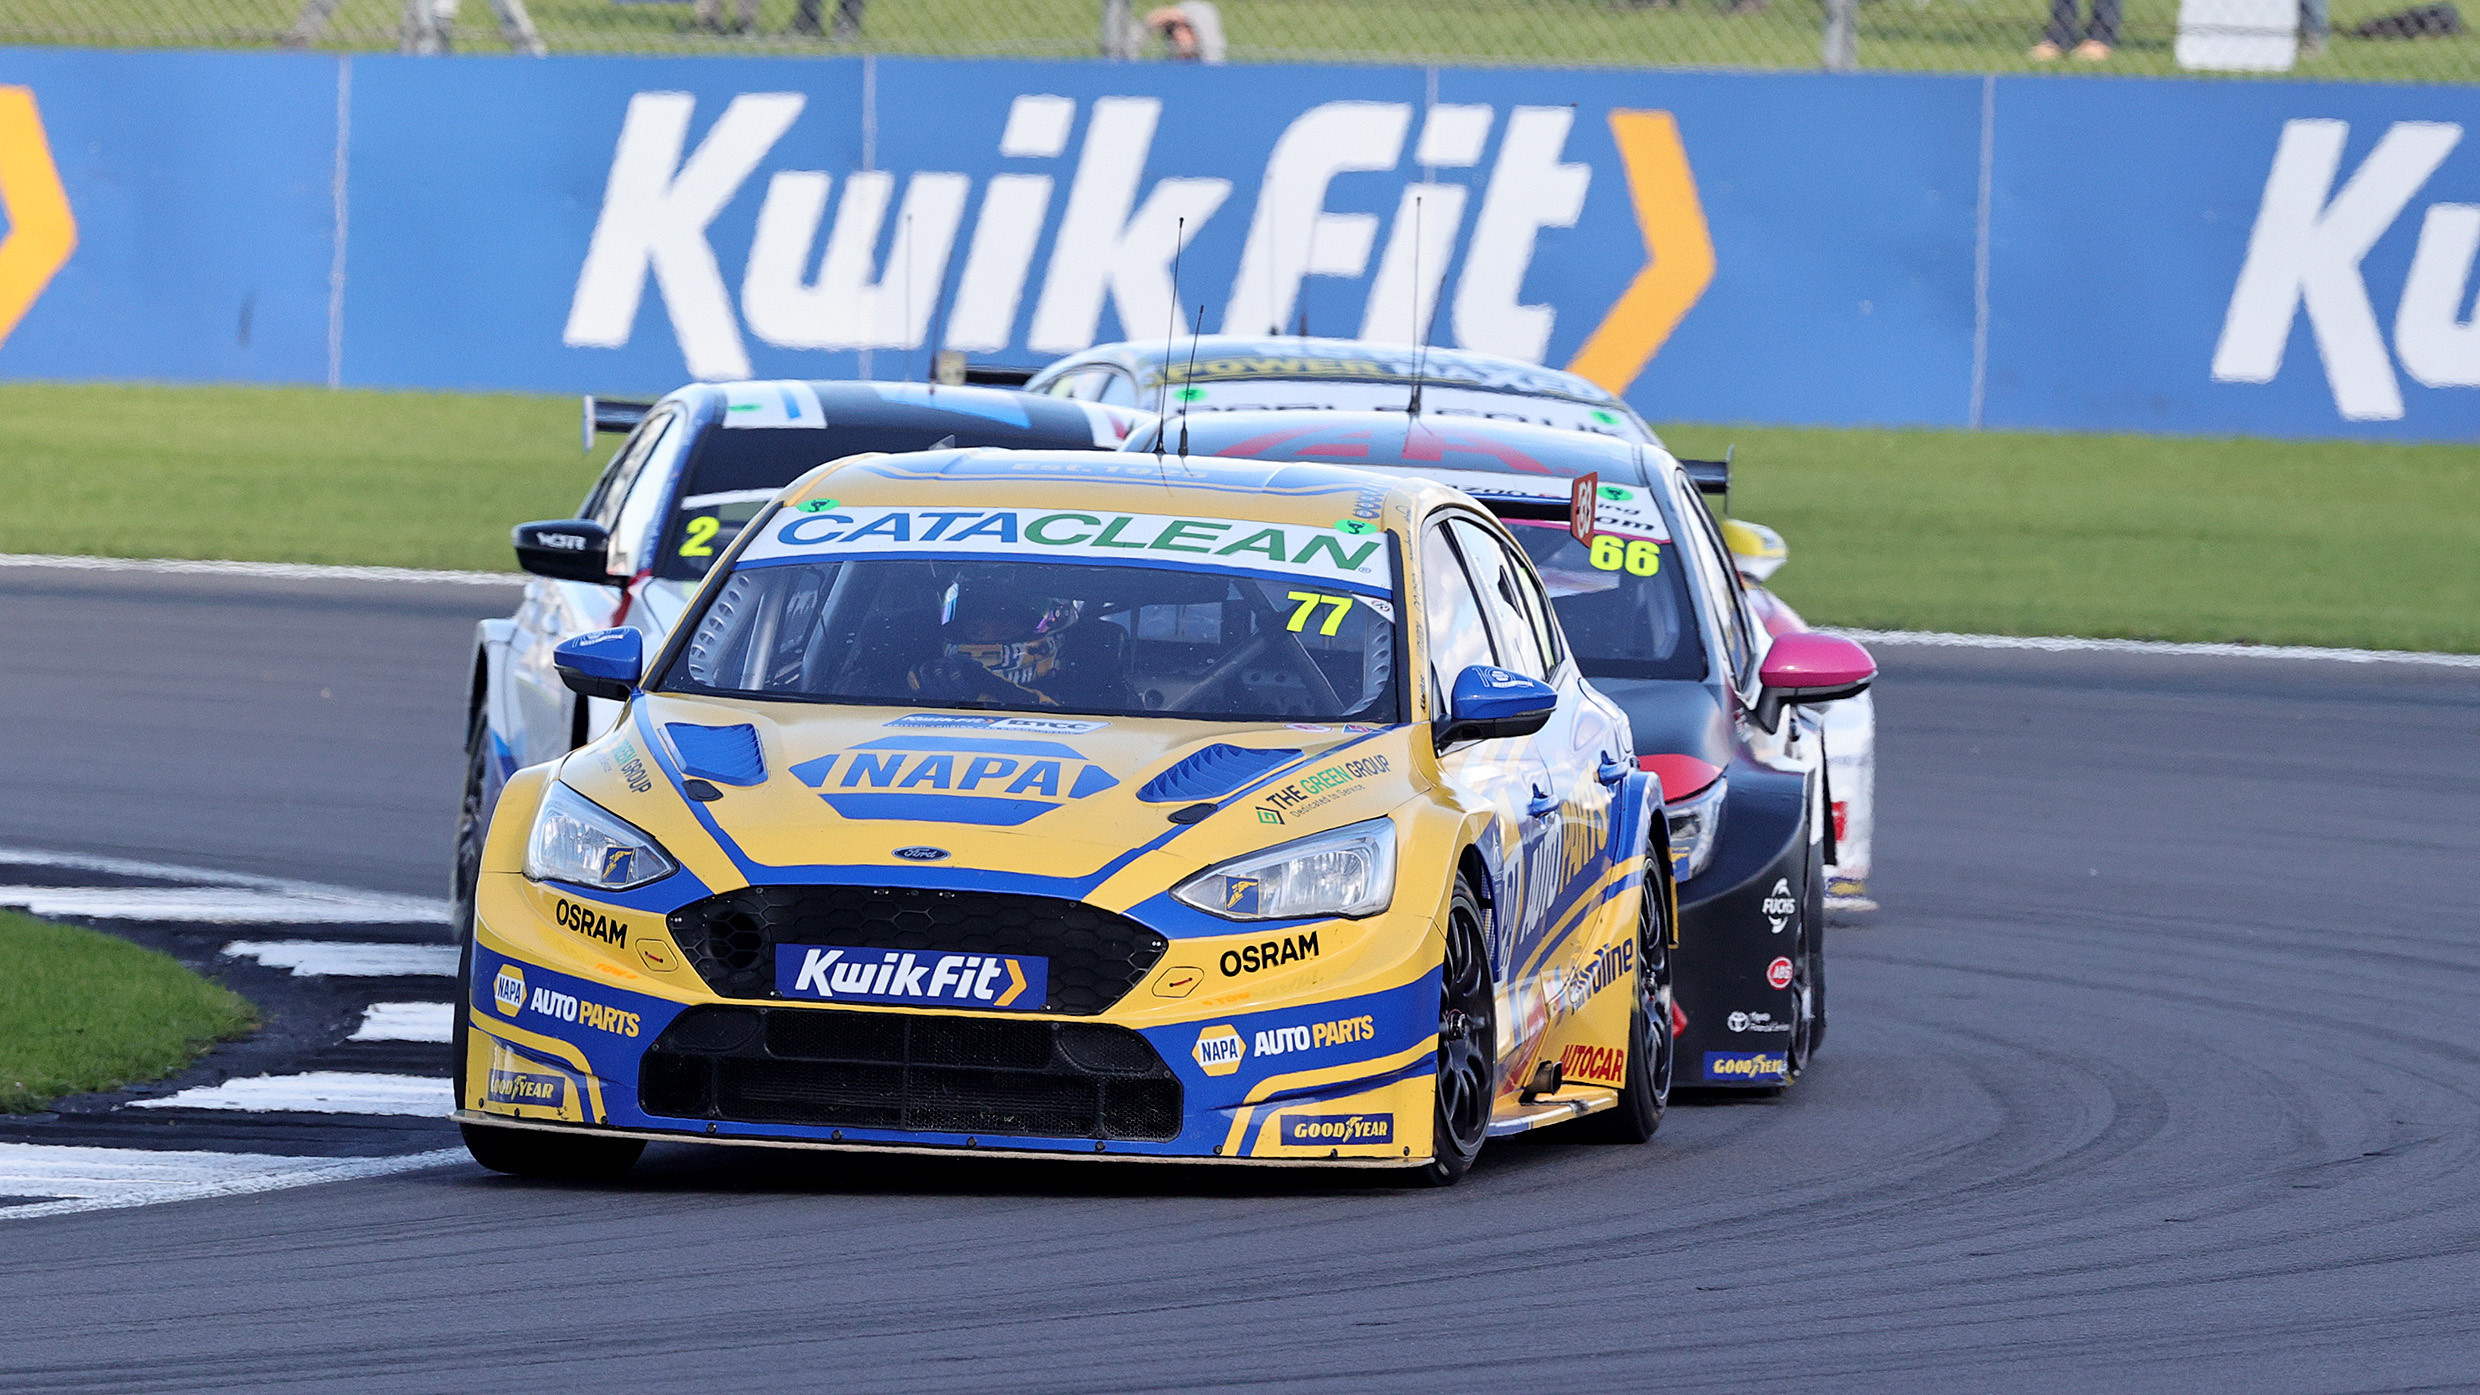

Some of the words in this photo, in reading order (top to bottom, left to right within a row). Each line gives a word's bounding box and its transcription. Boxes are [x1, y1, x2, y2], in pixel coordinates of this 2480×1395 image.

[678, 516, 721, 558] 2
[777, 510, 1381, 571] CATACLEAN
[1589, 534, 1661, 577] 66
[1286, 590, 1353, 637] 77
[621, 758, 652, 793] GROUP
[839, 753, 1061, 797] NAPA
[1265, 784, 1308, 810] THE
[1299, 765, 1353, 795] GREEN
[1345, 754, 1391, 779] GROUP
[1289, 793, 1331, 818] Dedicated
[903, 847, 938, 860] Ford
[555, 897, 628, 950] OSRAM
[1761, 897, 1796, 915] FUCHS
[1219, 930, 1320, 977] OSRAM
[495, 974, 524, 1006] NAPA
[530, 986, 578, 1023] AUTO
[578, 1000, 642, 1039] PARTS
[1201, 1037, 1239, 1063] NAPA
[1253, 1025, 1311, 1058] AUTO
[1311, 1014, 1375, 1049] PARTS
[1293, 1116, 1389, 1143] GOODYEAR
